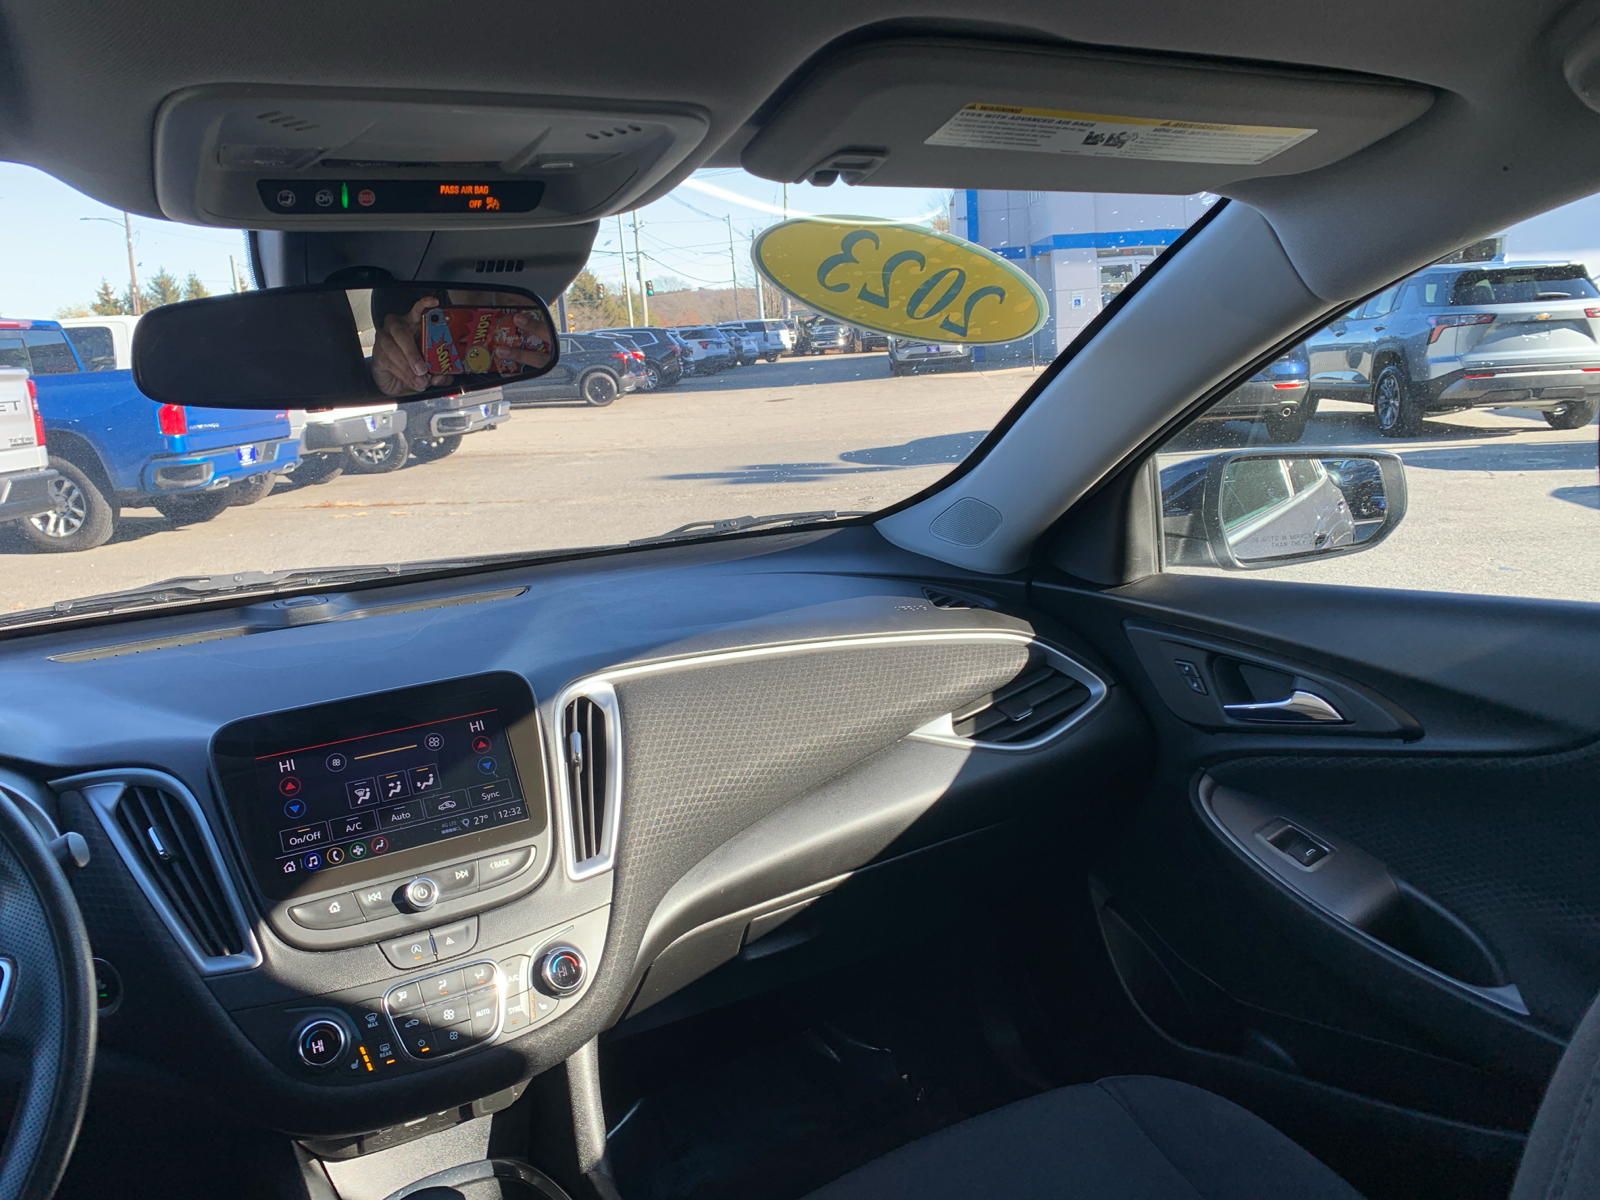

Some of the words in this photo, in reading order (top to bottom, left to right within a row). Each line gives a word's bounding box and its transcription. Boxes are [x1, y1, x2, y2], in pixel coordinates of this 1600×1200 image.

[1008, 115, 1055, 124] ADVANCED
[440, 185, 459, 195] PASS
[461, 185, 473, 195] AIR
[474, 185, 489, 195] BAG
[469, 199, 482, 209] OFF
[469, 719, 485, 733] HI
[279, 759, 296, 773] HI
[481, 790, 500, 802] Sync
[391, 811, 411, 822] Auto
[498, 806, 522, 819] 12:32
[345, 821, 363, 833] A/C
[289, 830, 322, 846] On/Off
[508, 973, 519, 983] A/C
[475, 1007, 490, 1018] AUTO
[508, 1004, 523, 1015] SYNC
[367, 1021, 379, 1029] MAX
[311, 1039, 325, 1054] HI
[379, 1050, 393, 1058] REAR
